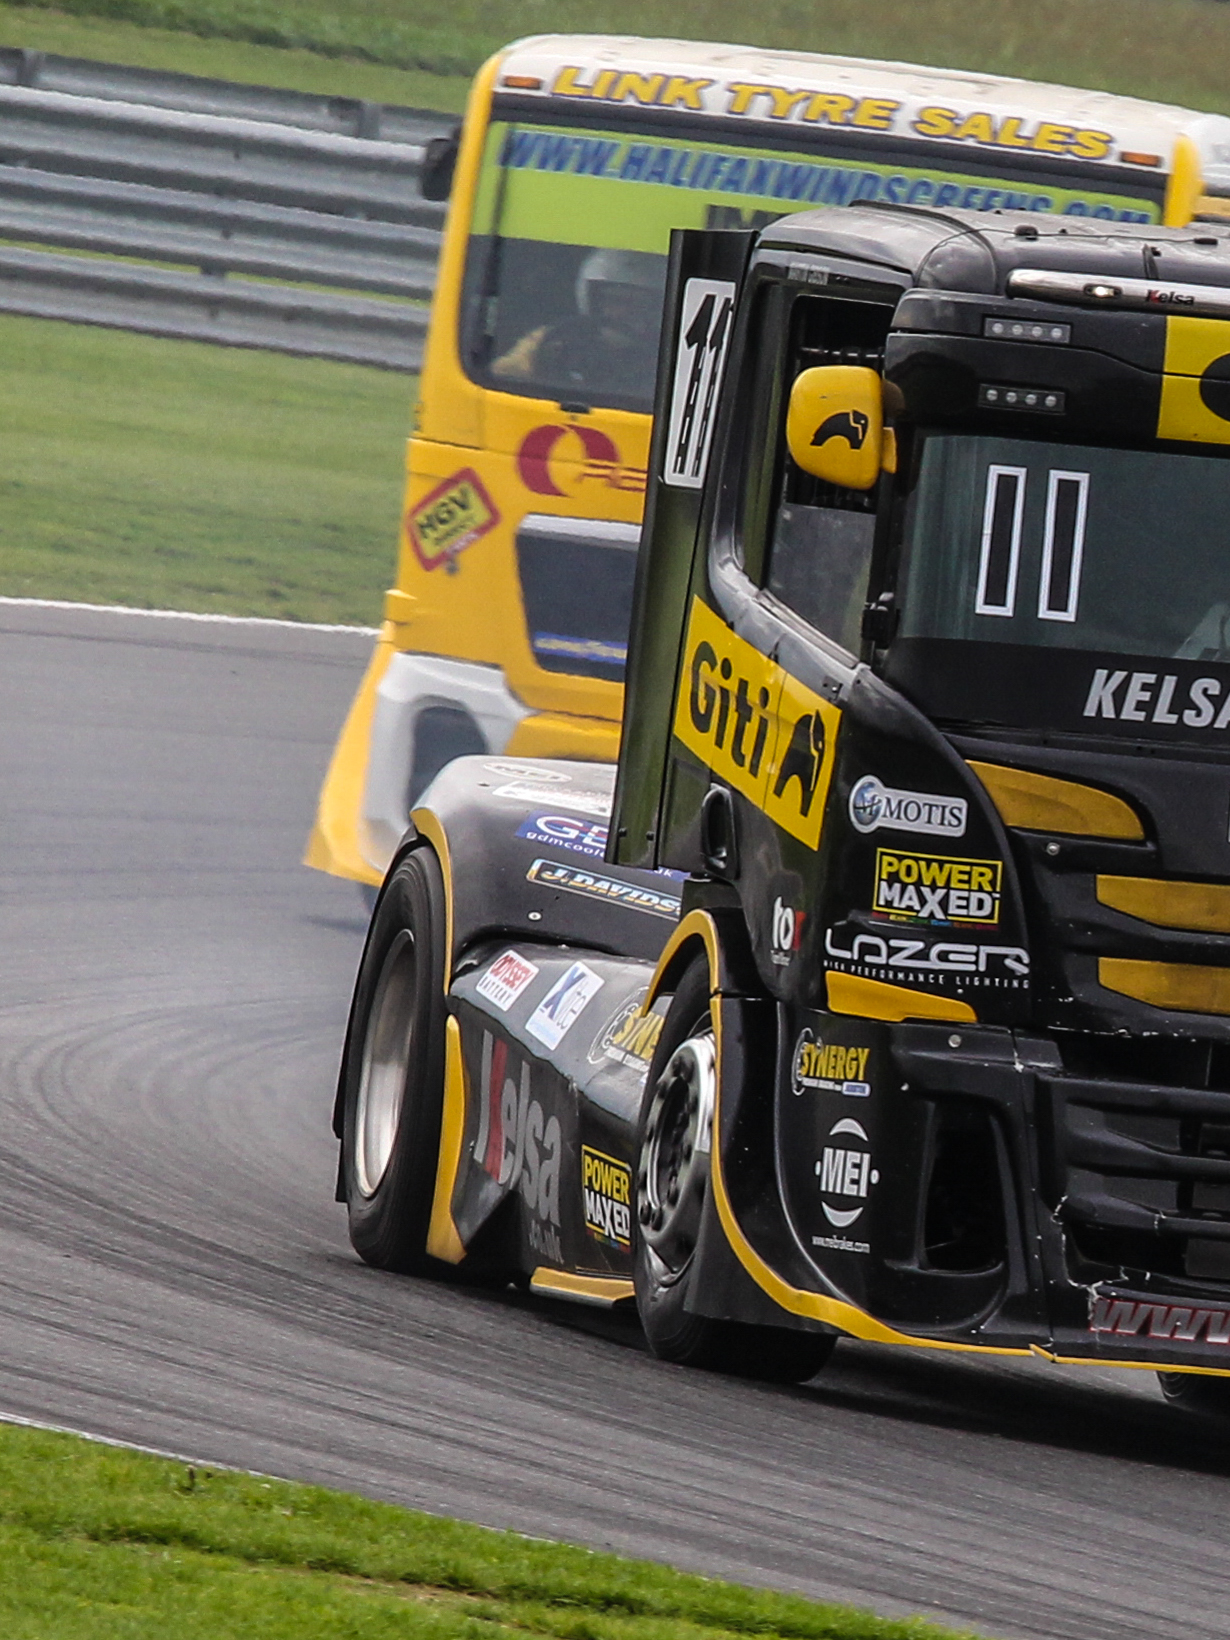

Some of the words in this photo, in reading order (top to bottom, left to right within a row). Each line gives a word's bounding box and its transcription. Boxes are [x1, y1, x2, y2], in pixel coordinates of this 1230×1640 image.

[551, 65, 711, 111] LINK
[726, 81, 900, 130] TYRE
[913, 106, 1115, 160] SALES
[500, 129, 1153, 224] WWW.HALIFAXWINDSCREEN
[1145, 289, 1195, 305] Kelsa
[690, 641, 768, 779] Giti
[882, 797, 963, 828] MOTIS
[540, 867, 680, 916] J.DAVIDS
[881, 855, 993, 891] POWER
[878, 880, 994, 920] MAXED
[490, 954, 534, 991] ODYSSEY
[825, 928, 1030, 975] LAZER
[851, 965, 945, 985] PERFORMANCE
[956, 976, 1029, 989] LIGHTING
[801, 1043, 870, 1081] SYNERGY
[473, 1029, 561, 1228] Kelsa
[584, 1154, 631, 1204] POWER
[820, 1147, 871, 1198] MEI
[584, 1188, 631, 1240] MAXED
